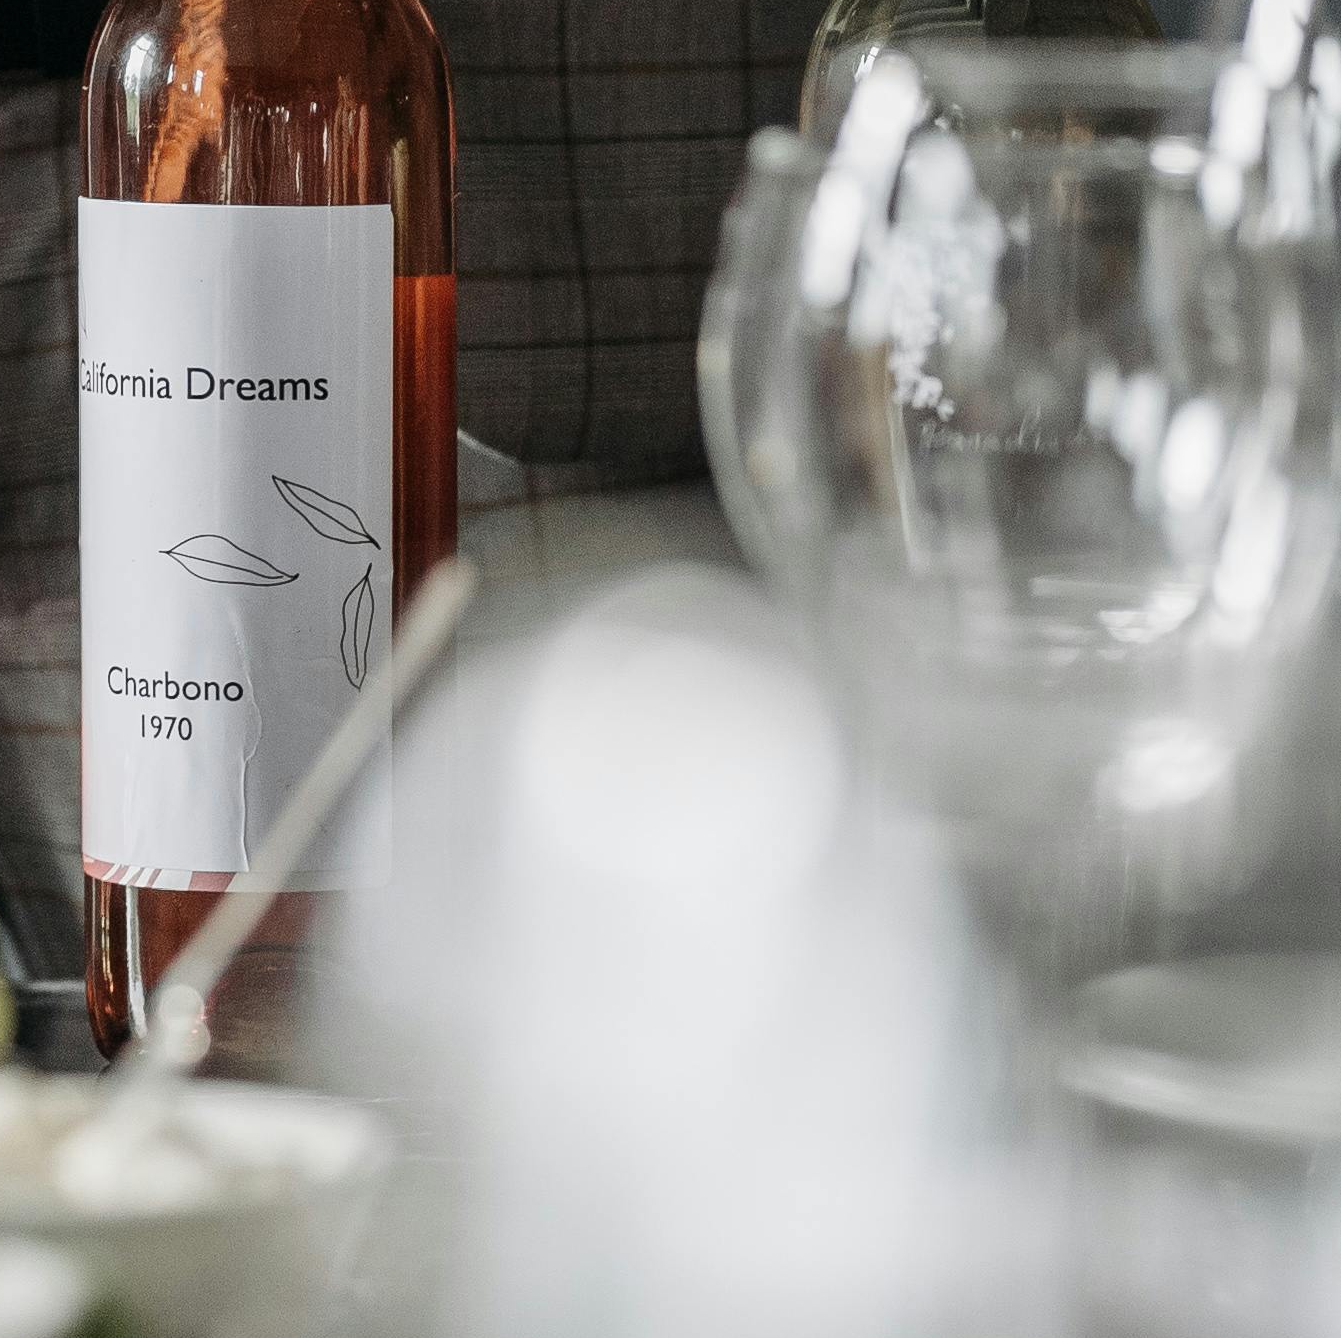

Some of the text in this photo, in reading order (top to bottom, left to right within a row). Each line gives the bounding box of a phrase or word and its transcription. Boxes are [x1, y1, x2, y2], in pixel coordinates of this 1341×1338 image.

[81, 358, 329, 401] California Dreams
[107, 666, 244, 703] Charbono
[140, 715, 193, 741] 1970
